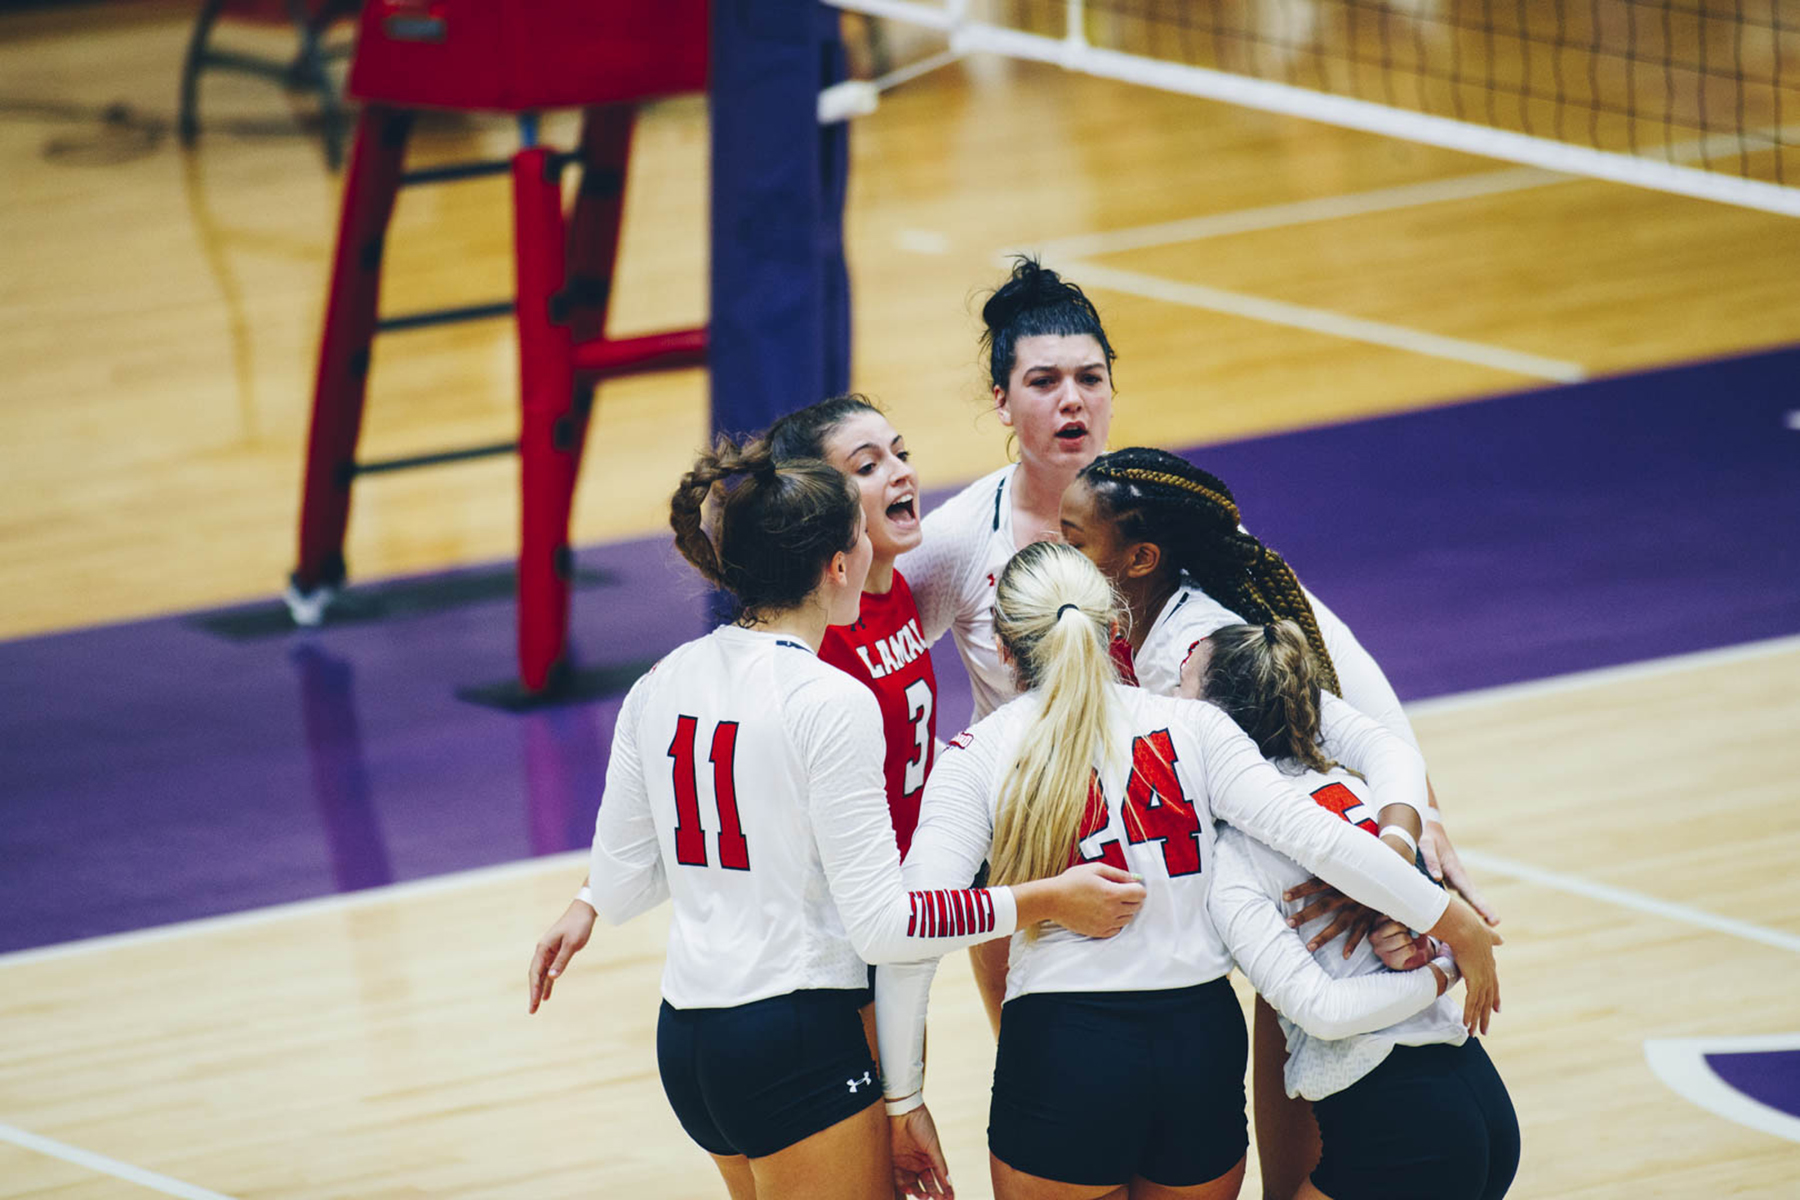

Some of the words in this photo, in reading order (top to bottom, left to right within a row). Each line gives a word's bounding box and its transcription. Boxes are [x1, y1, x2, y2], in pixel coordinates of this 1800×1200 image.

[667, 714, 751, 871] 11
[904, 676, 934, 798] 3
[907, 887, 995, 938] CARDINALS
